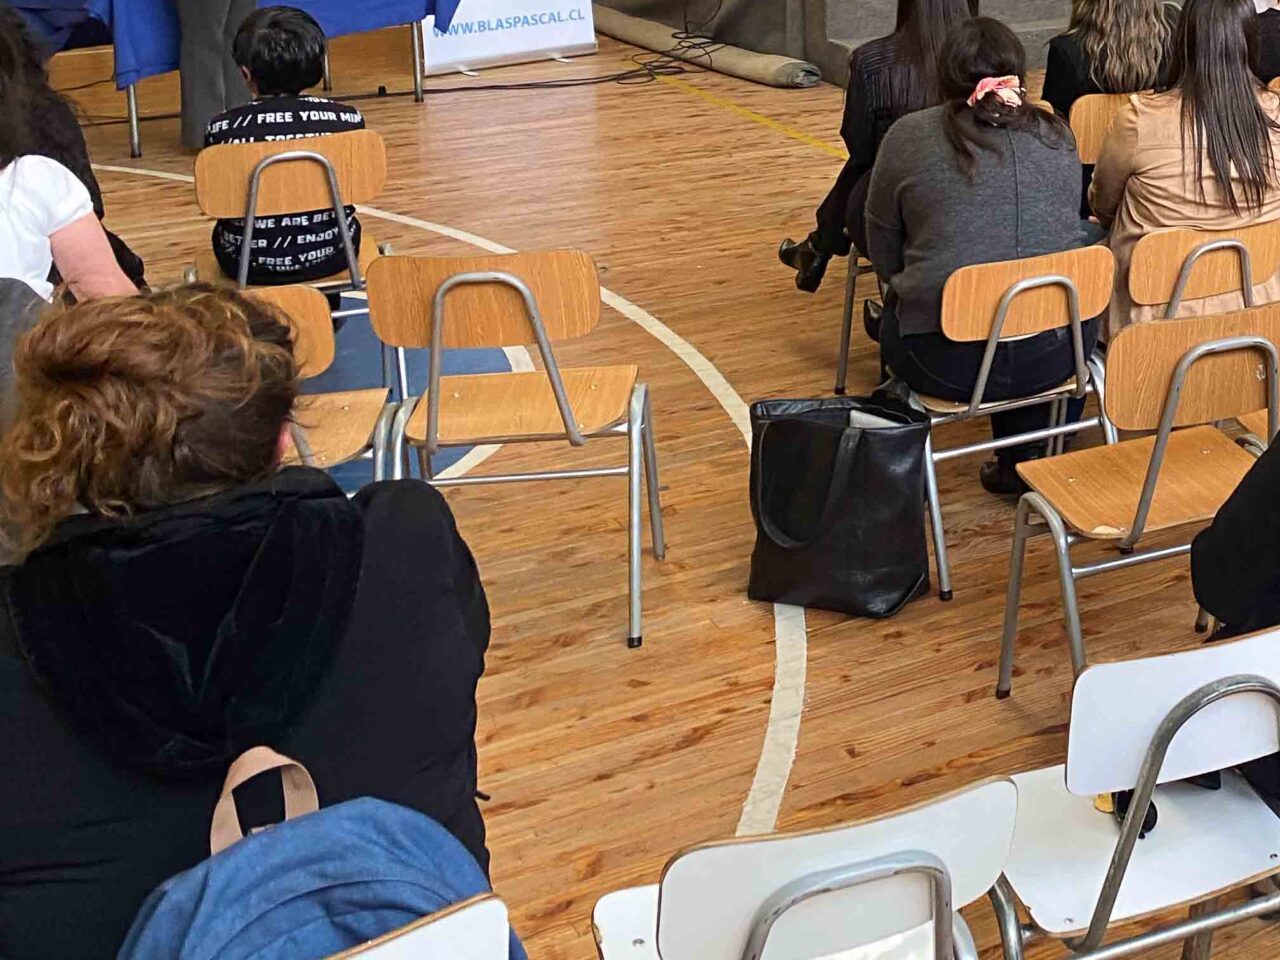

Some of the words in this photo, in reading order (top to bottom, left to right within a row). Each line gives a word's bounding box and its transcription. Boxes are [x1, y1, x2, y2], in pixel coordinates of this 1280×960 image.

[257, 111, 294, 125] FREE
[299, 110, 338, 122] YOUR
[339, 110, 363, 124] MIN
[254, 219, 276, 229] WE
[281, 215, 309, 227] ARE
[312, 210, 337, 224] BET
[296, 226, 339, 245] ENJOY
[257, 256, 293, 266] FREE
